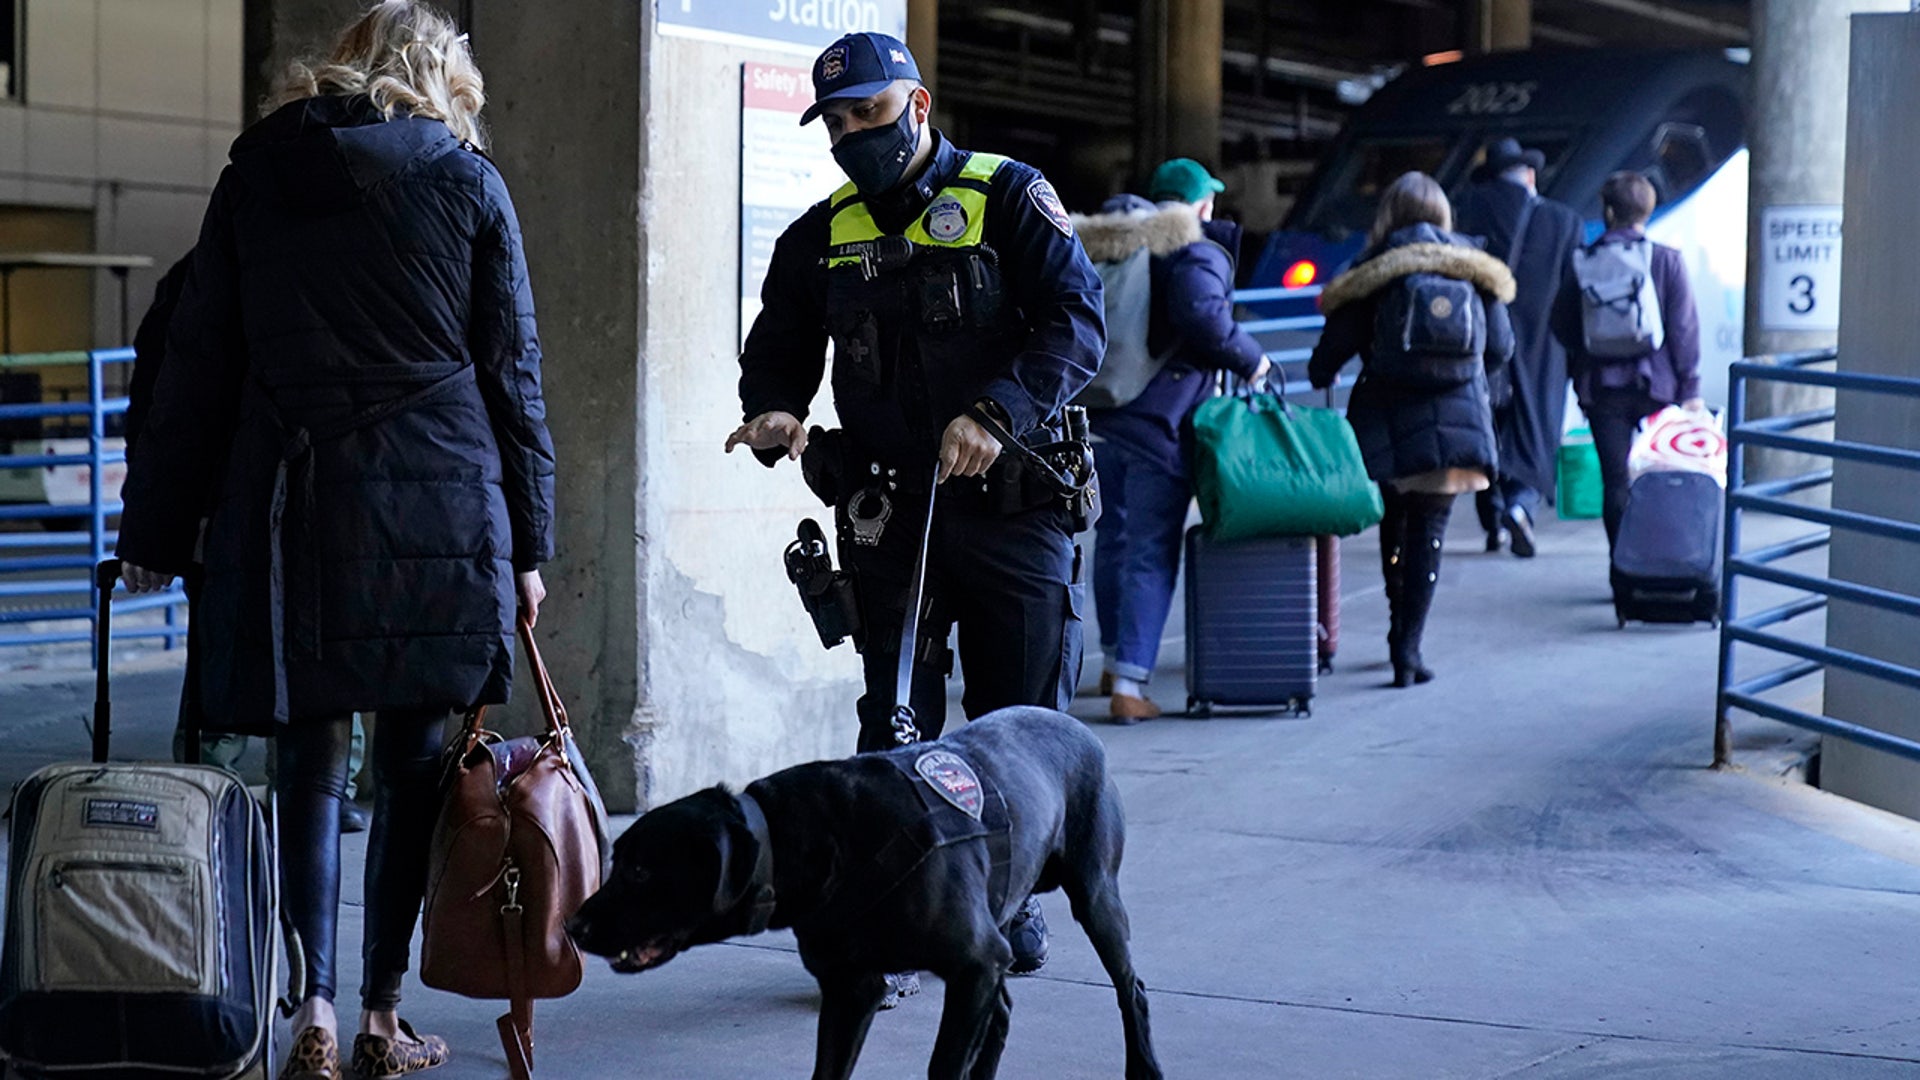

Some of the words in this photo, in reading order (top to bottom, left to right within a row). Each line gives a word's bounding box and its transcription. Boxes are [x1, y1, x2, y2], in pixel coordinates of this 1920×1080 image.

[768, 0, 880, 31] Station
[753, 67, 797, 98] Safety
[1770, 221, 1841, 238] SPEED
[1775, 244, 1832, 262] LIMIT
[1788, 274, 1816, 315] 3
